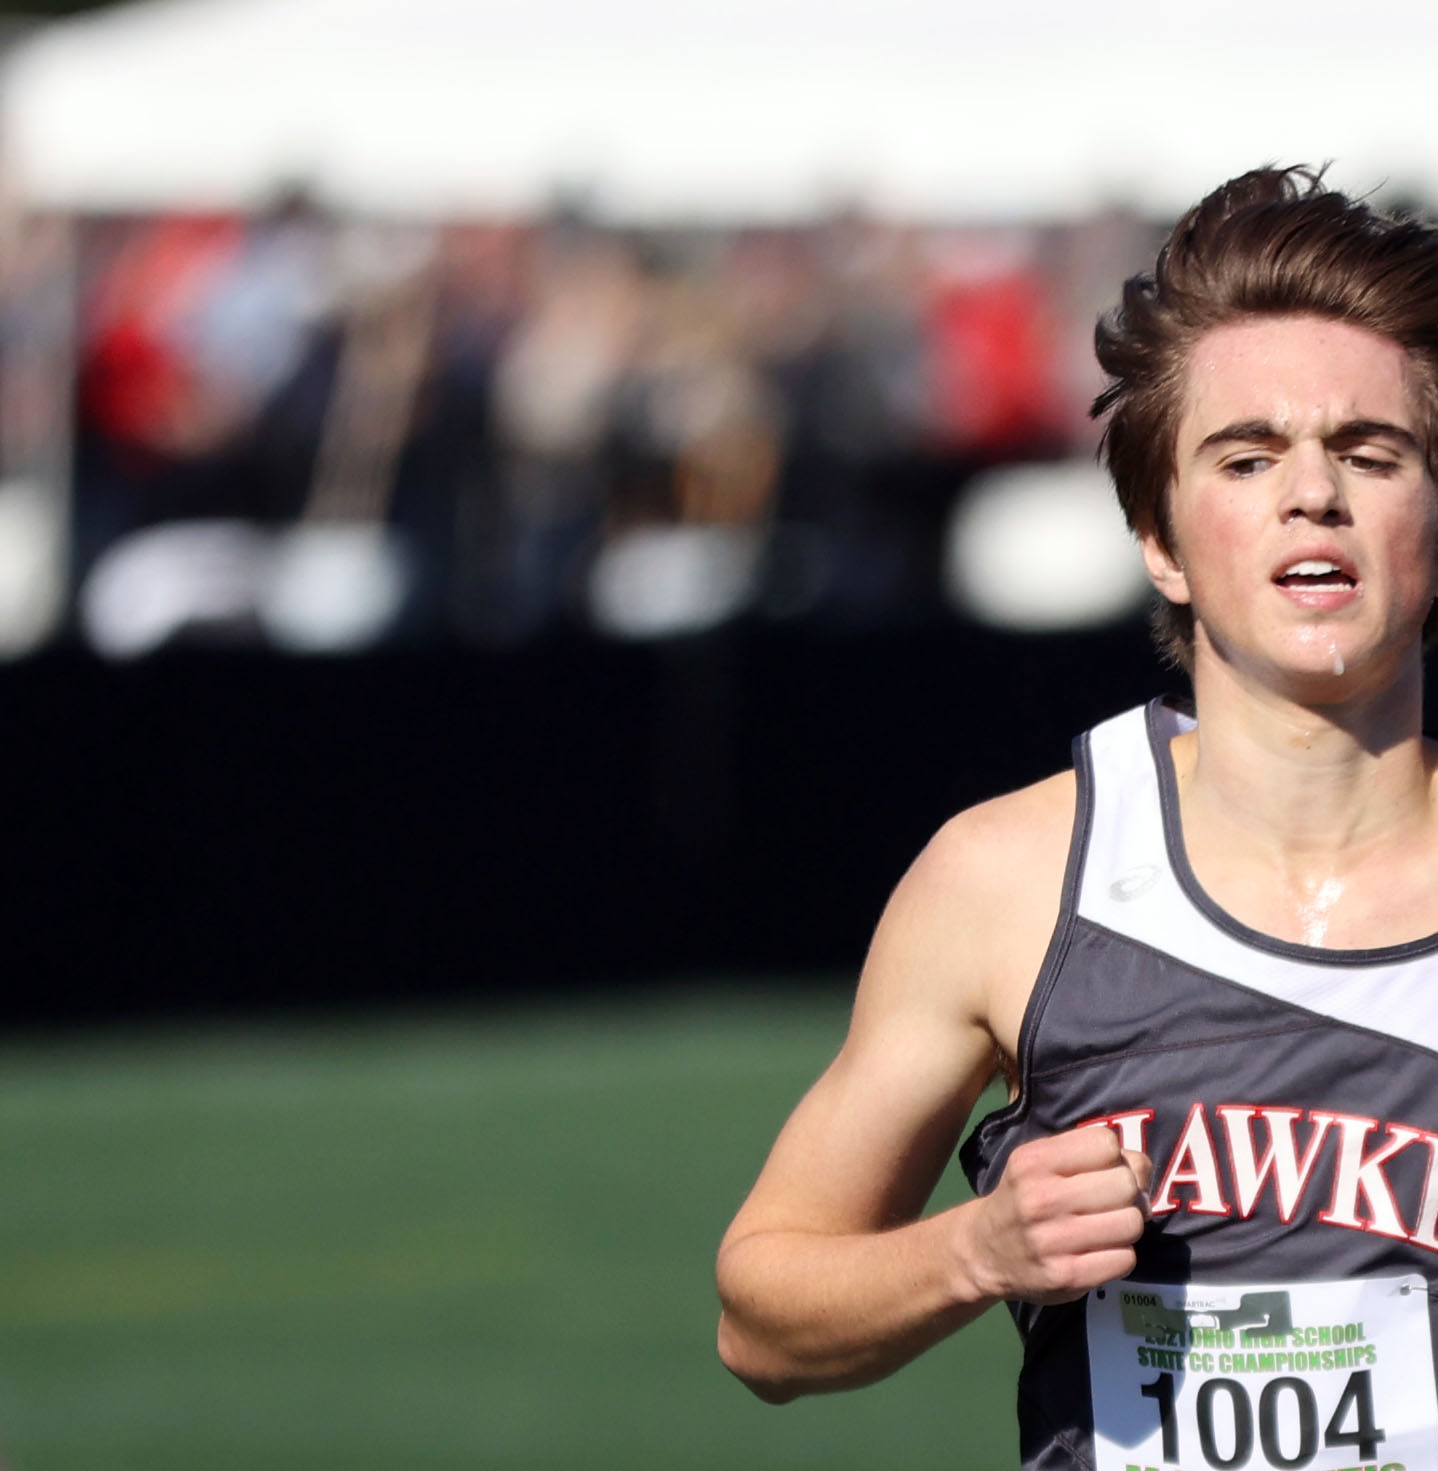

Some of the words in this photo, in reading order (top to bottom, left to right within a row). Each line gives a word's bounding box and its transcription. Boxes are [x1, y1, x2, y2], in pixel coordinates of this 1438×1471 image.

[1123, 1294, 1157, 1307] 01004
[1189, 1326, 1235, 1349] OHIO
[1290, 1322, 1367, 1346] SCHOOL
[1137, 1345, 1186, 1371] STATE
[1188, 1351, 1216, 1373] CC
[1218, 1344, 1378, 1373] CHAMPIONSHIPS
[1141, 1369, 1386, 1471] 1004
